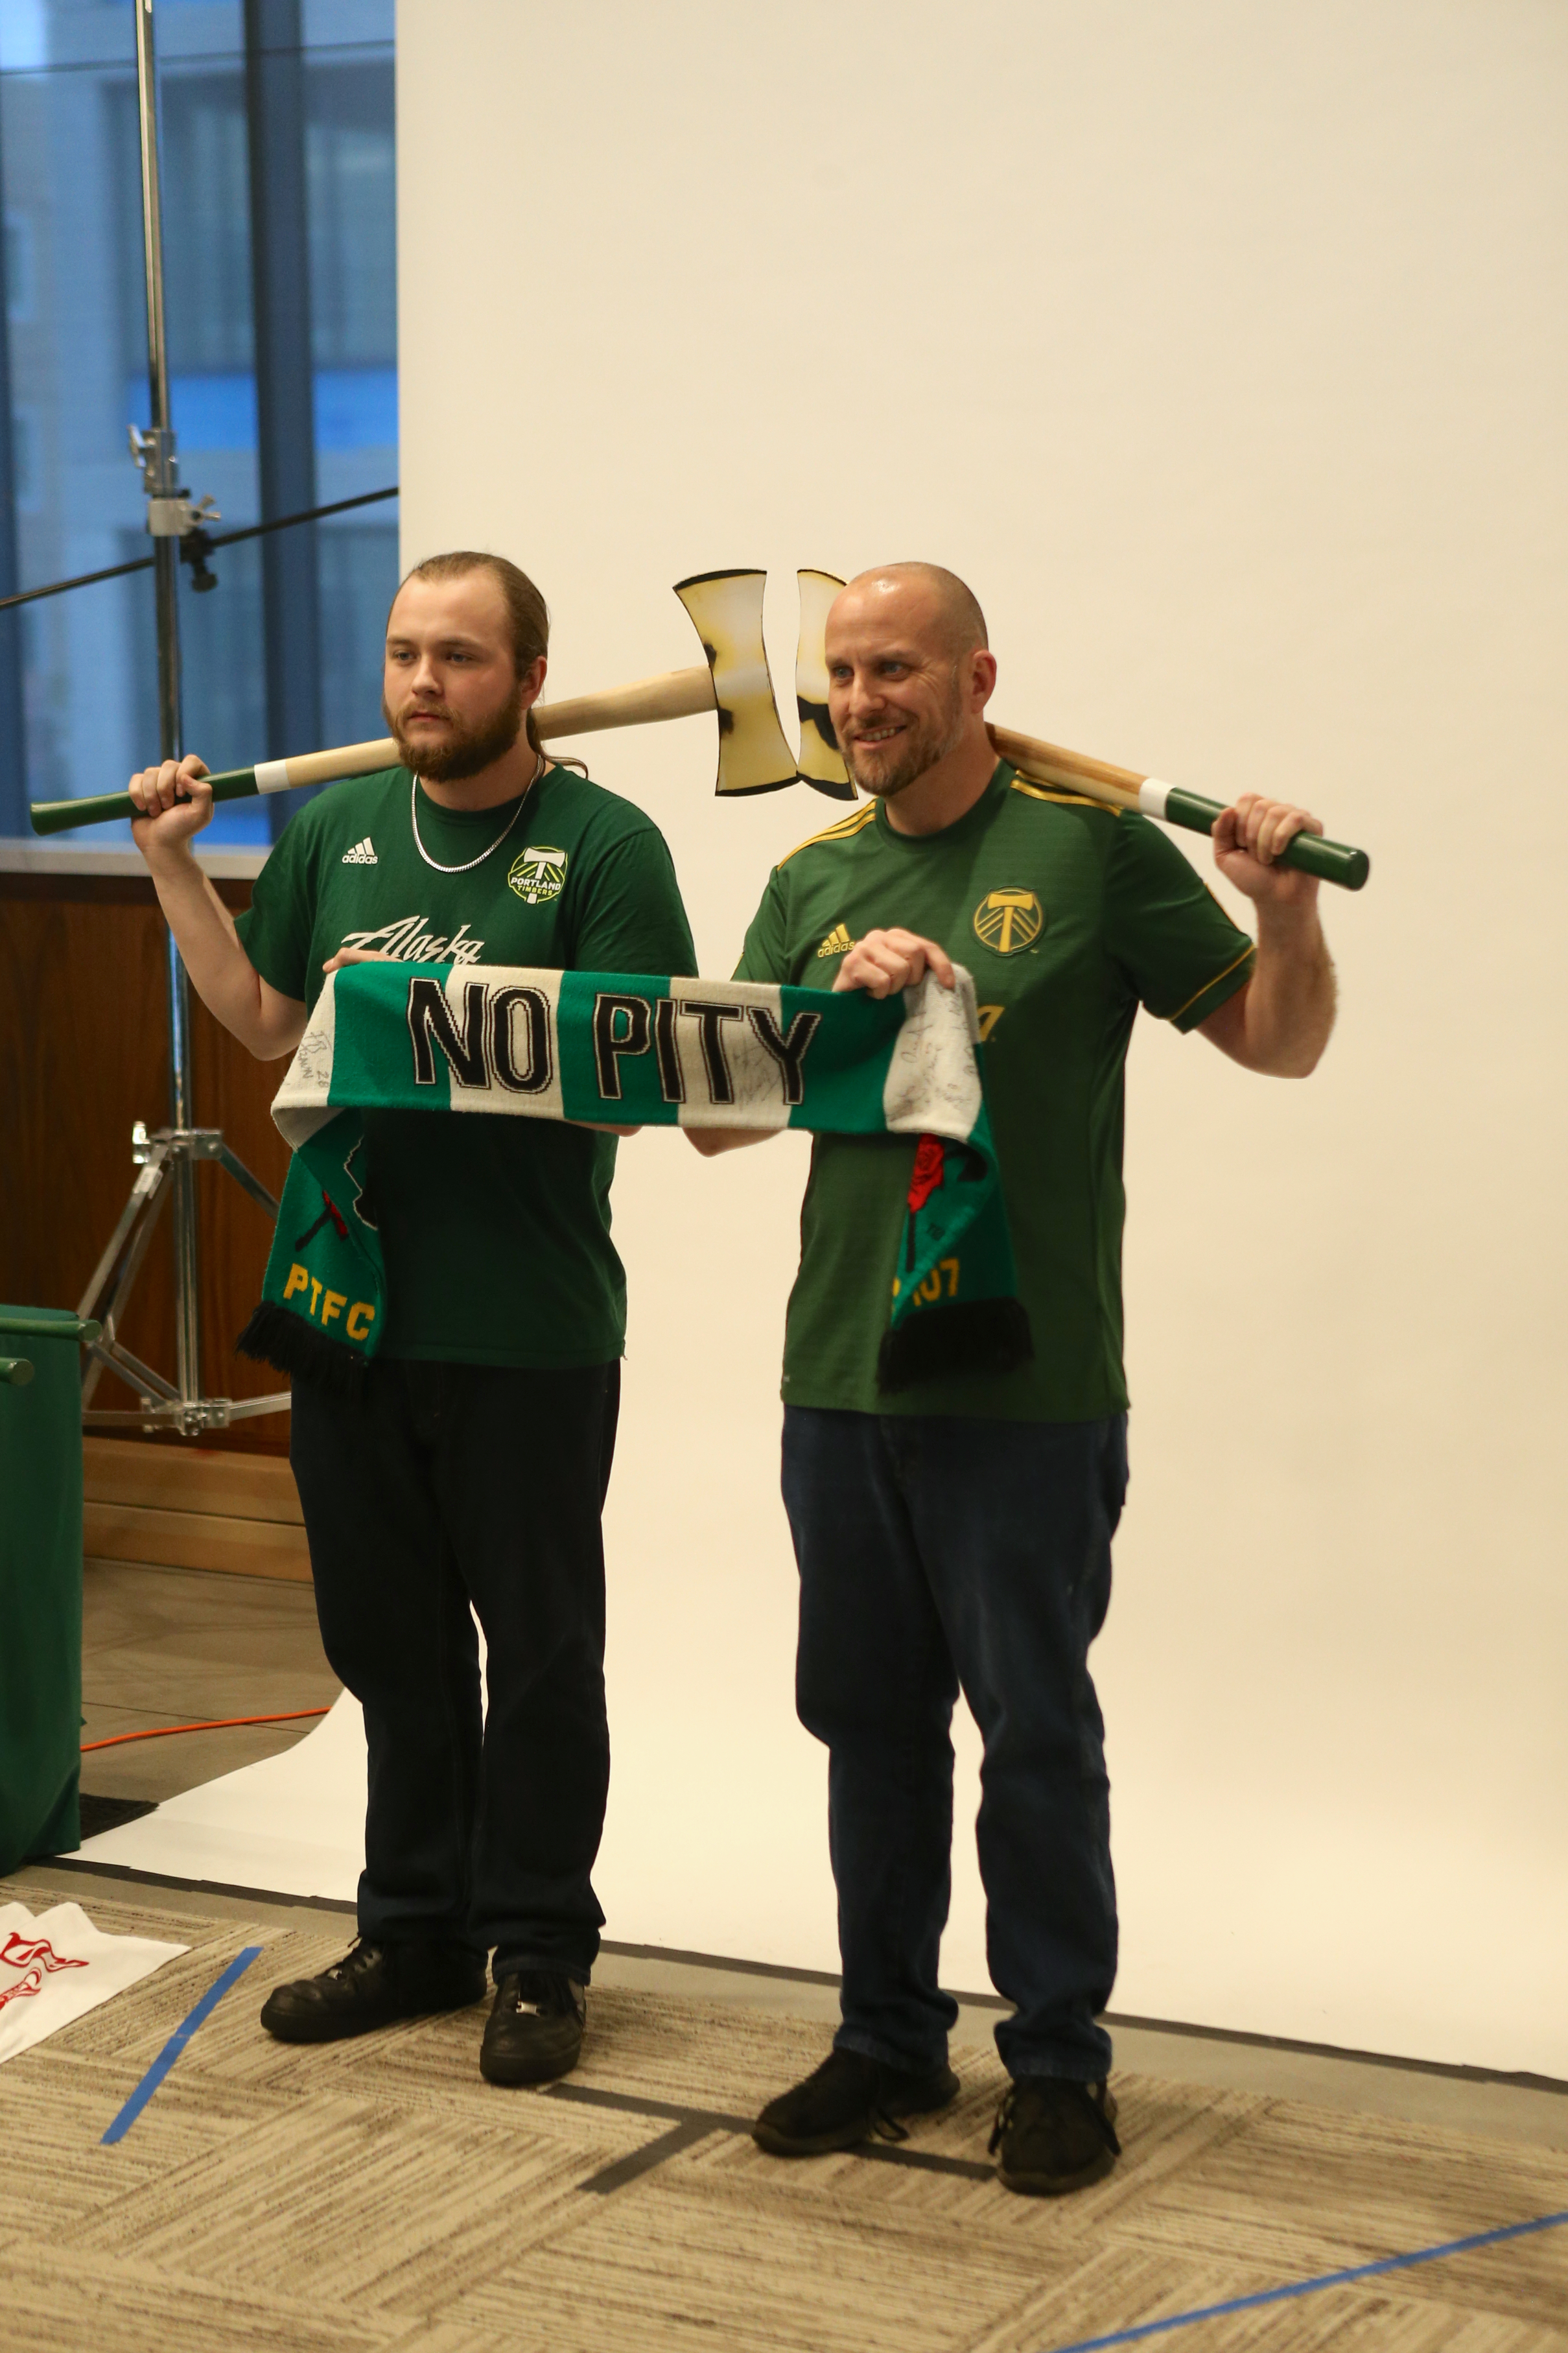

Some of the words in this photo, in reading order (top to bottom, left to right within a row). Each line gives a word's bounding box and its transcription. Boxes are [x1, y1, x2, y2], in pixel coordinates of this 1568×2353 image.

[342, 853, 379, 865] adidas
[510, 877, 561, 891] PORTLAND
[517, 885, 553, 896] TIMBERS
[341, 915, 485, 965] Alaska
[817, 941, 855, 958] adidas
[406, 976, 554, 1095] NO
[592, 992, 823, 1106] PITY
[283, 1262, 375, 1341] PTFC
